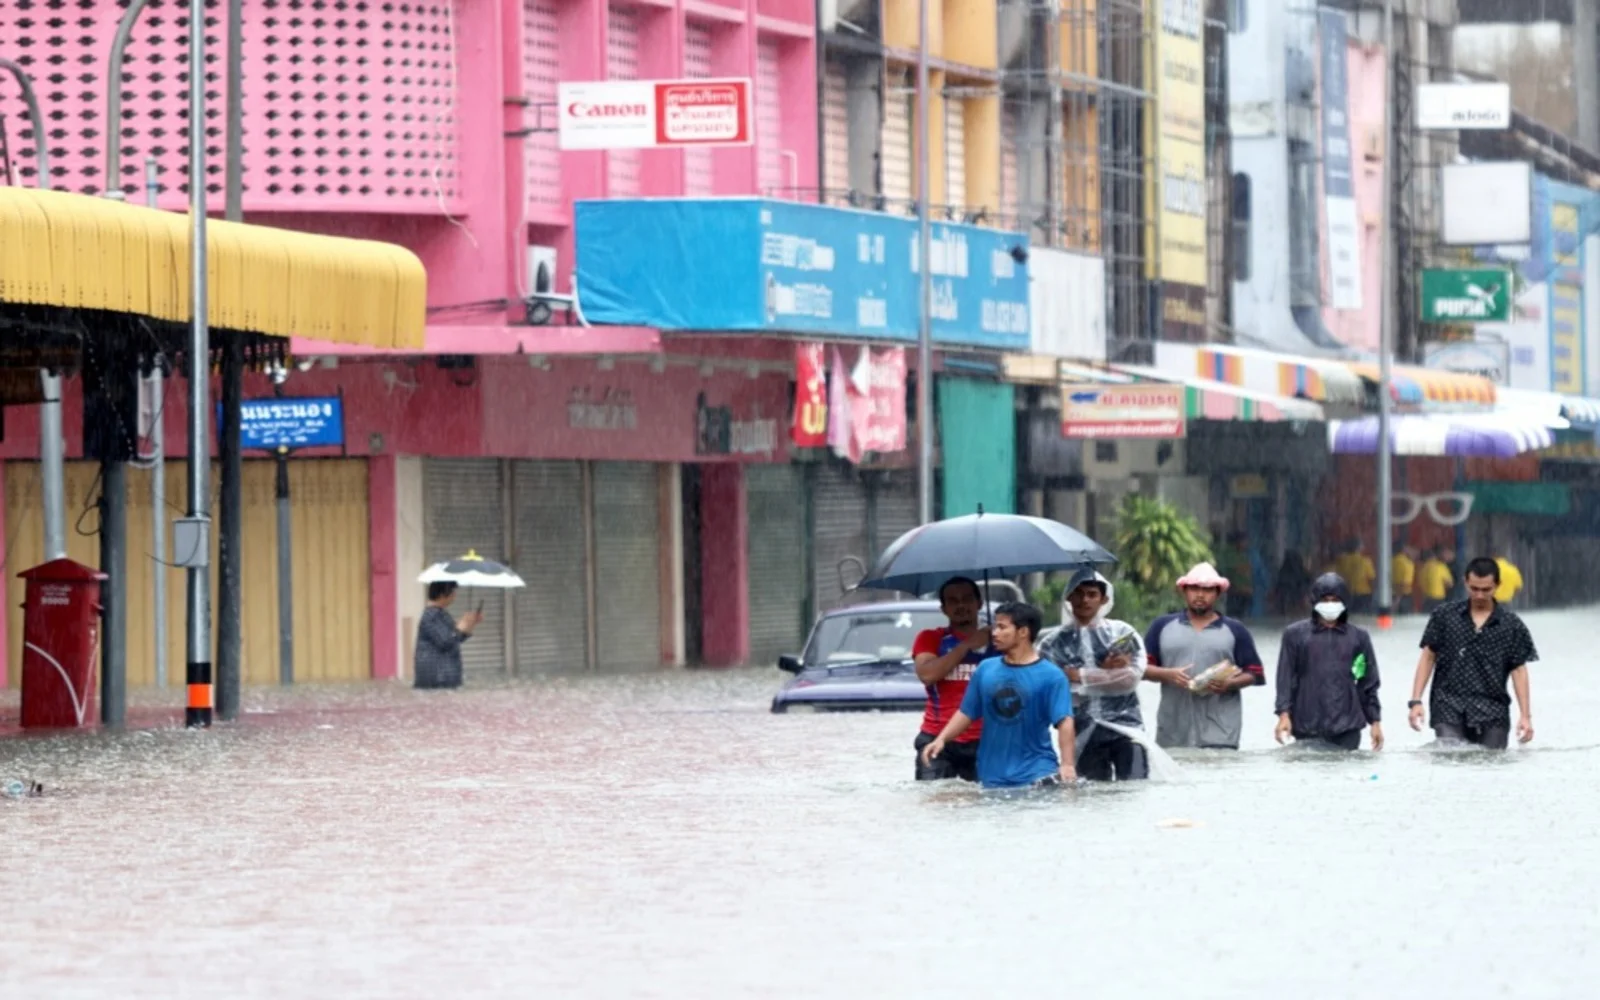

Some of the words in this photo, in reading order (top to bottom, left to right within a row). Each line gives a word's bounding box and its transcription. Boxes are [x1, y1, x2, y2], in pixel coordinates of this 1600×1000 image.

[567, 101, 647, 118] Canon
[1434, 297, 1485, 317] PUMA
[240, 403, 332, 420] นนระนอง
